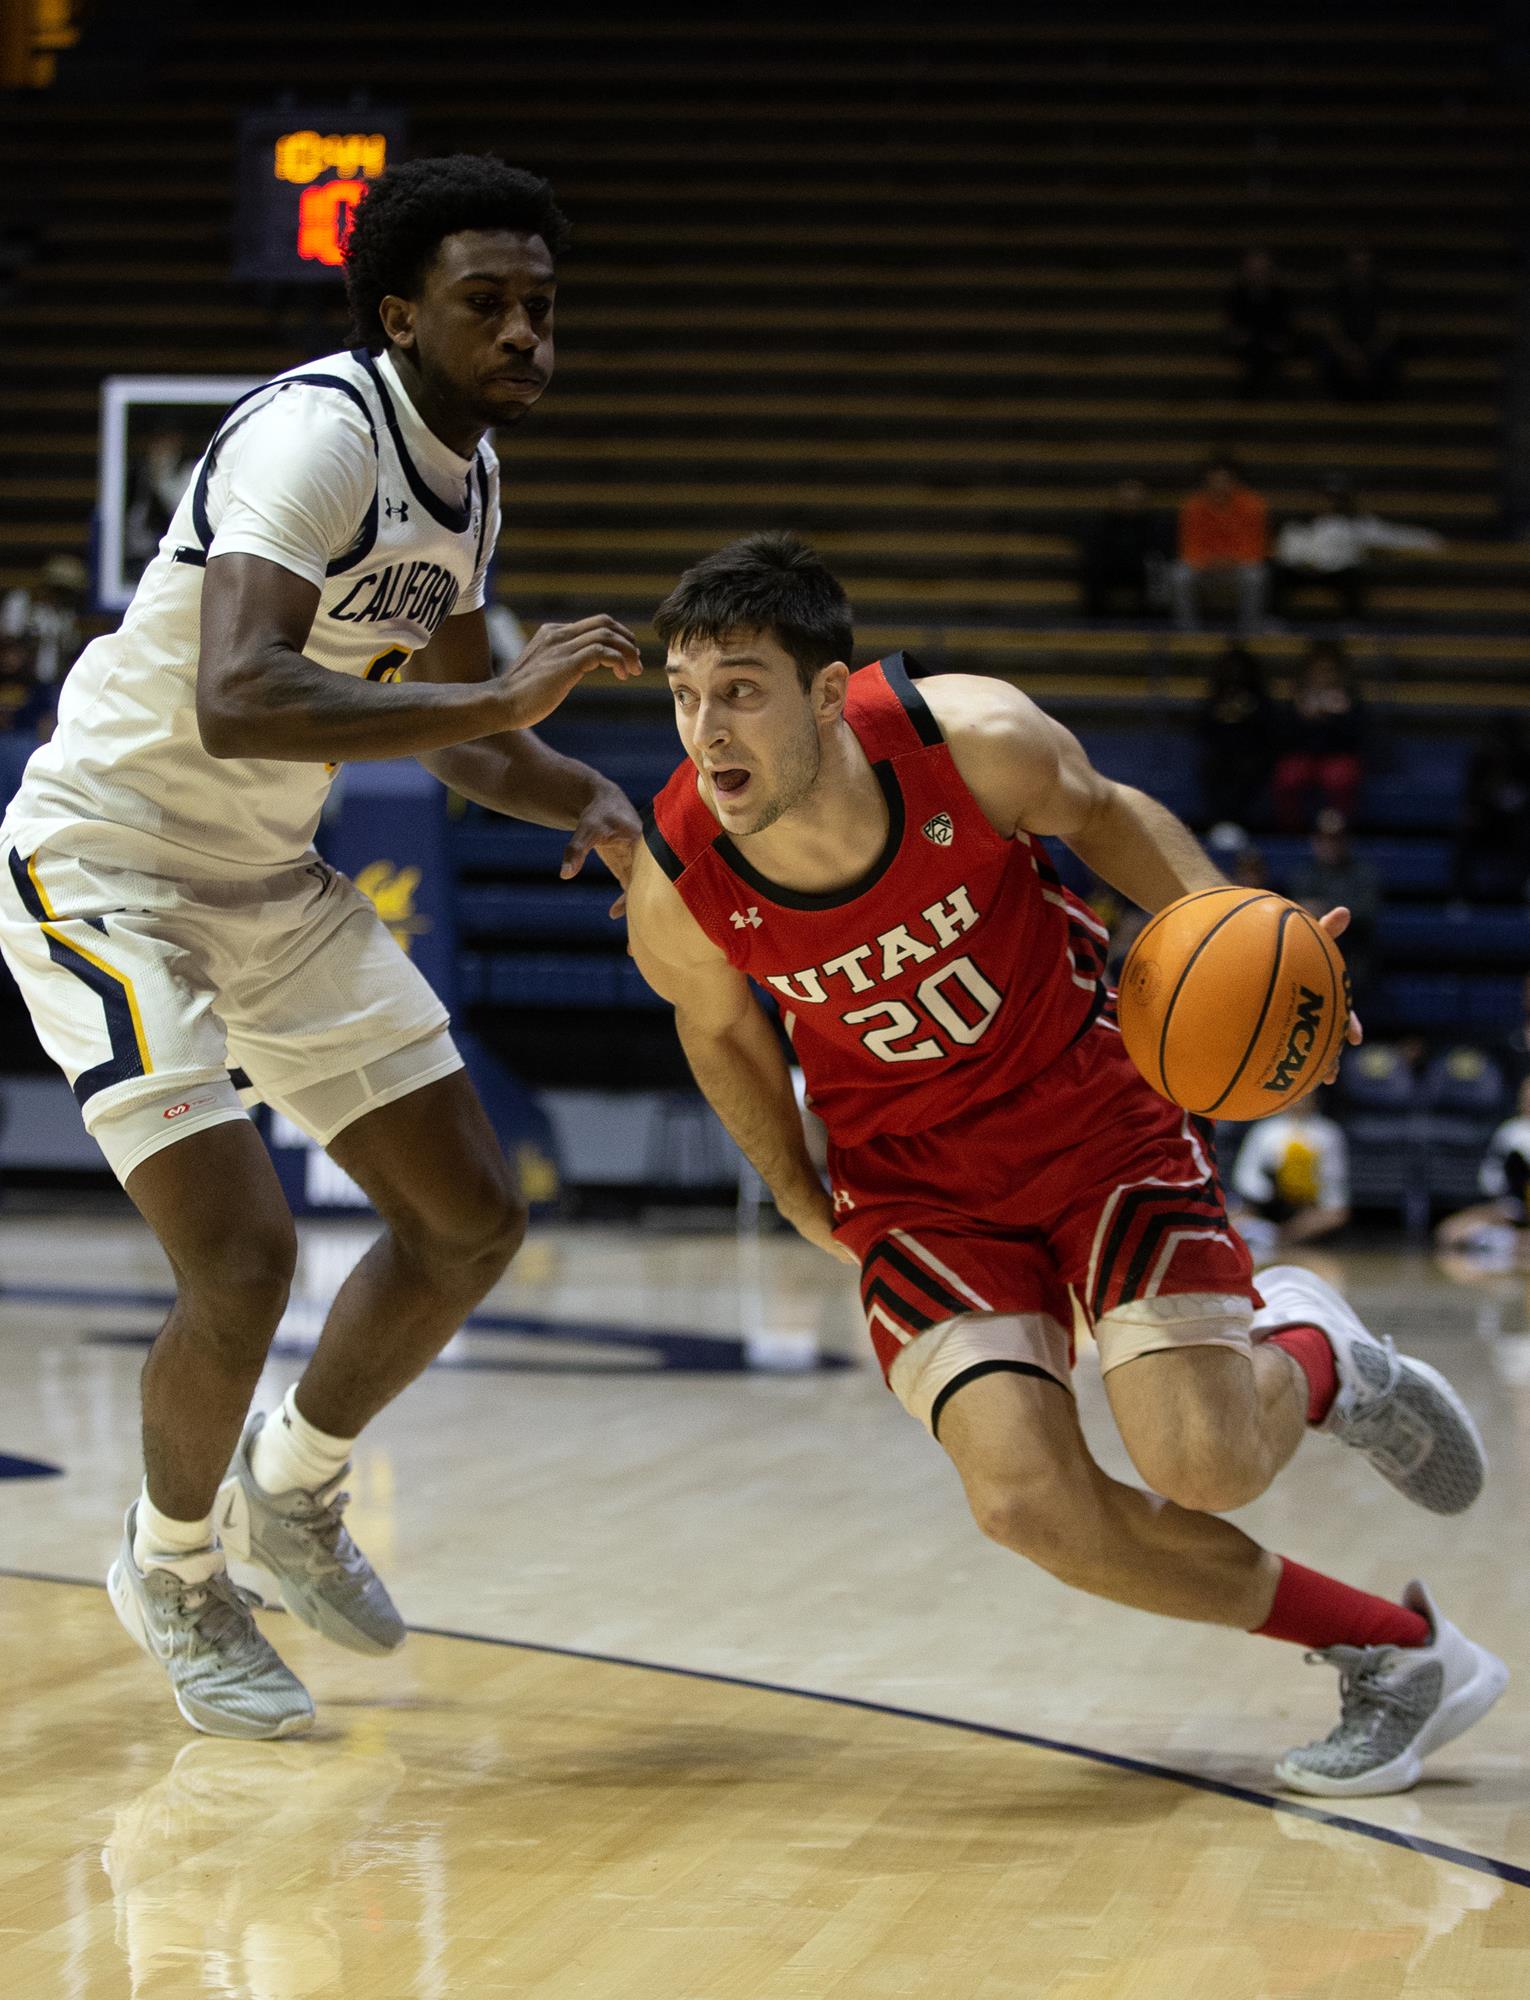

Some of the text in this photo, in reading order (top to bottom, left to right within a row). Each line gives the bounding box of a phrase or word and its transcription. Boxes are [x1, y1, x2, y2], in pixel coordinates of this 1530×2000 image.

[328, 561, 460, 636] CALIFORN
[923, 813, 952, 842] PAC
[935, 828, 952, 844] 12
[766, 884, 980, 1004] UTAH
[839, 955, 1003, 1063] 20
[1262, 983, 1325, 1092] NCAA
